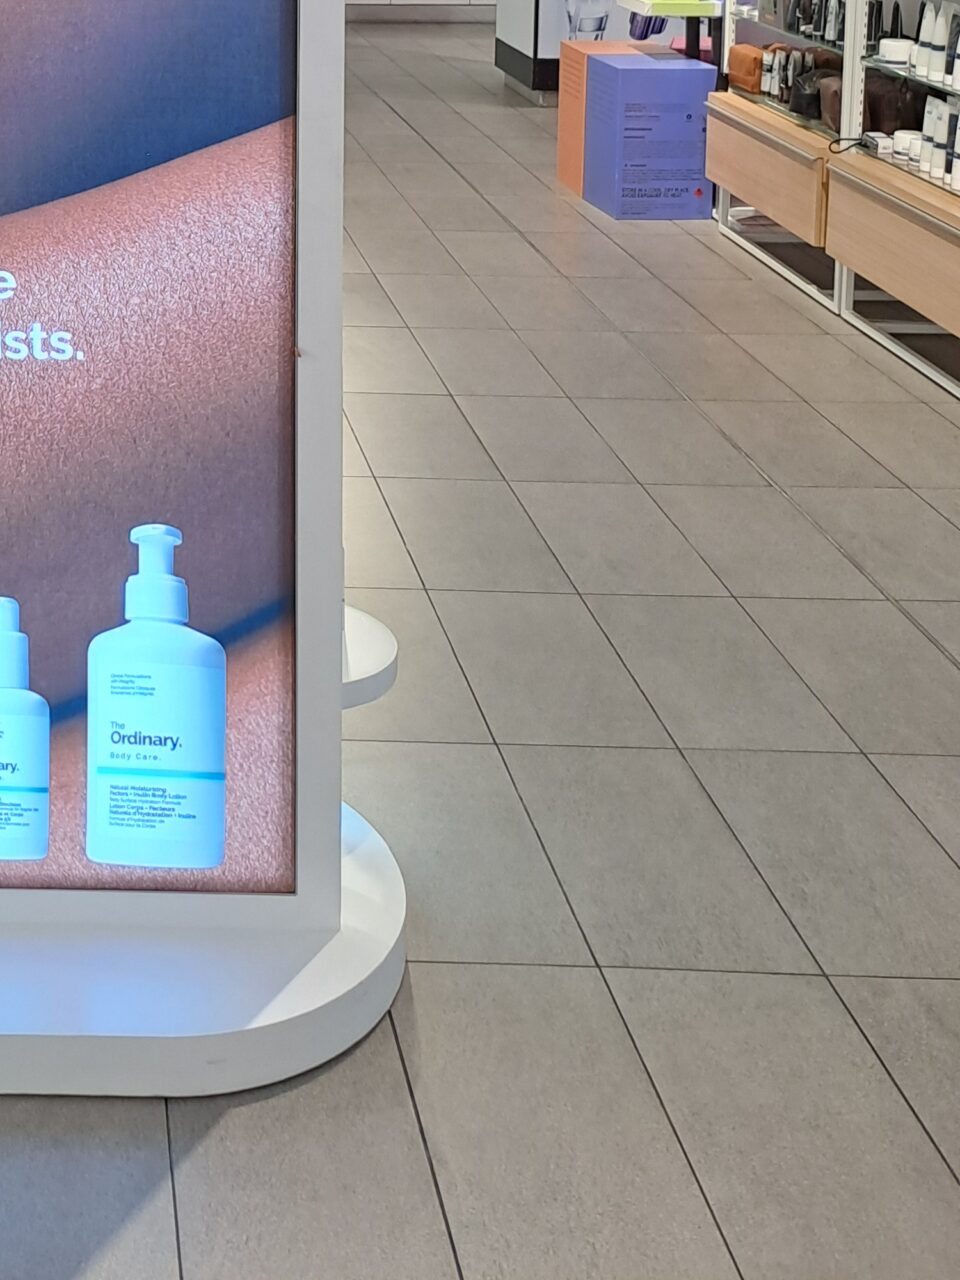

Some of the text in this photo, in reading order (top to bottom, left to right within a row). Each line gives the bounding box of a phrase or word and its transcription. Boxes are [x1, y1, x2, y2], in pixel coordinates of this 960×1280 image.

[110, 721, 126, 730] The
[110, 731, 183, 752] Ordinary.
[110, 752, 132, 761] Body
